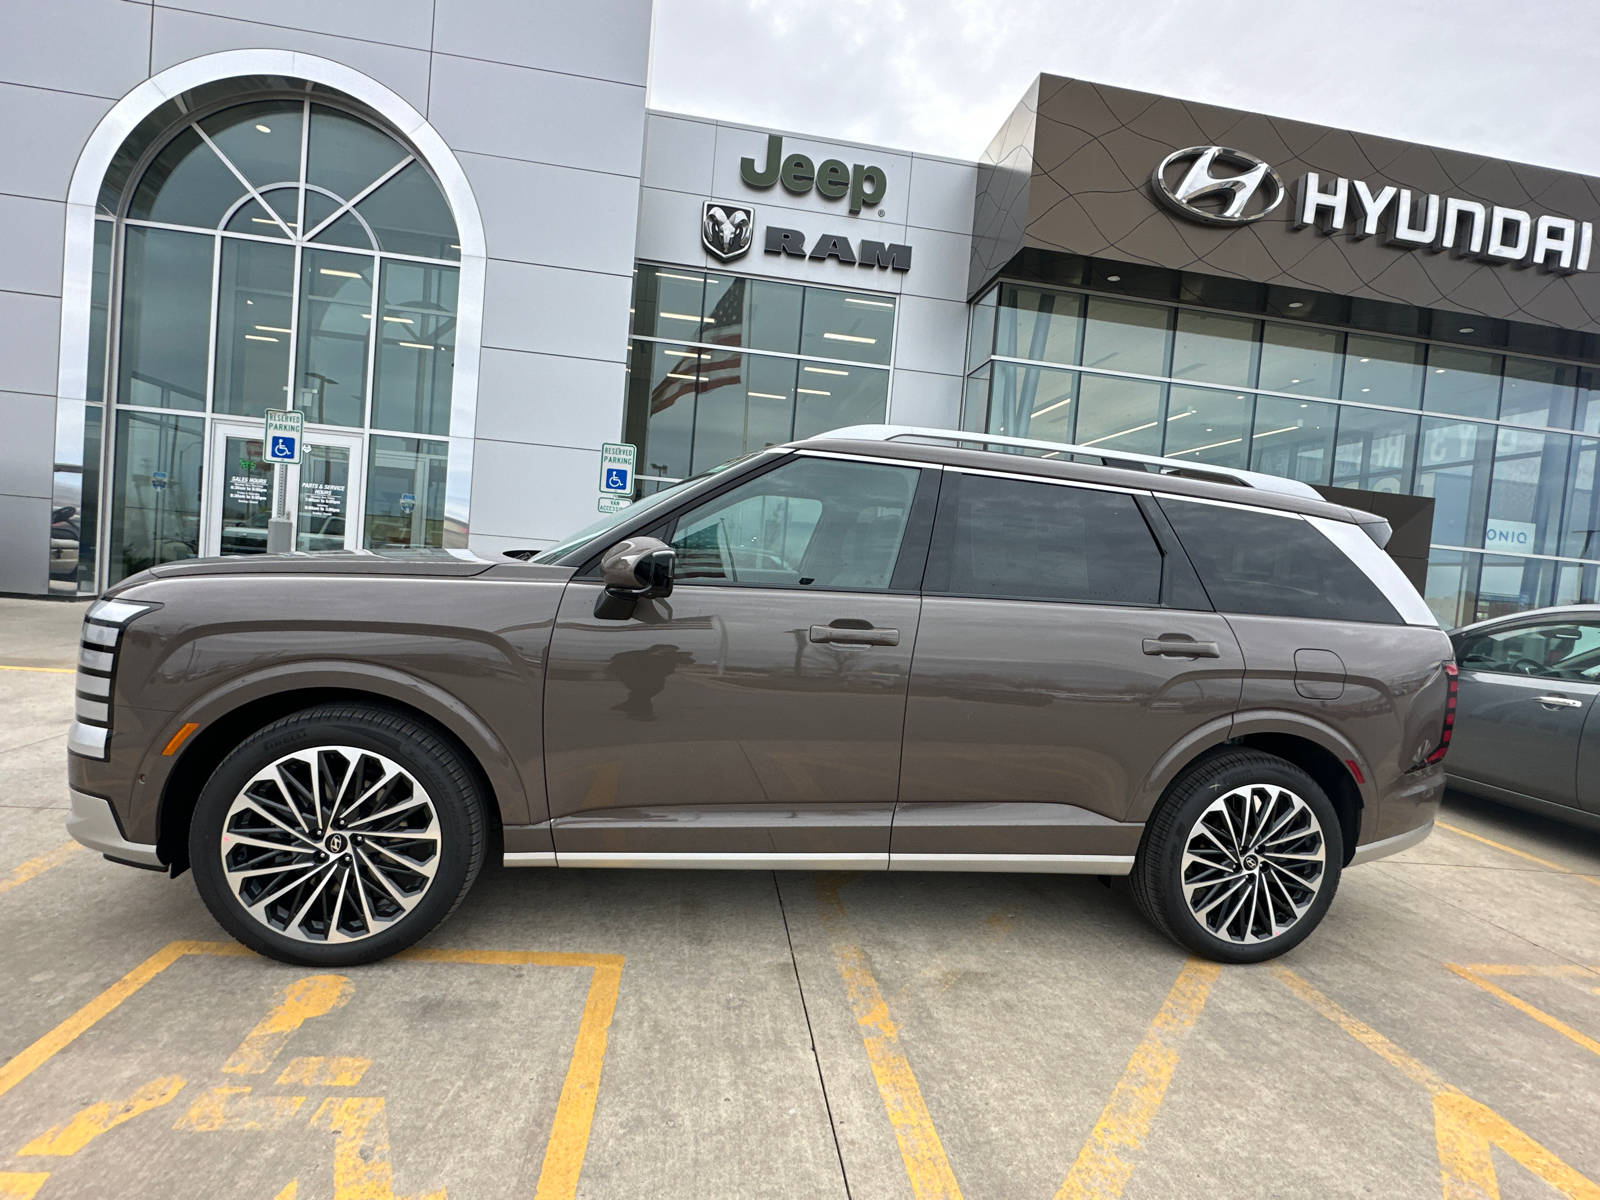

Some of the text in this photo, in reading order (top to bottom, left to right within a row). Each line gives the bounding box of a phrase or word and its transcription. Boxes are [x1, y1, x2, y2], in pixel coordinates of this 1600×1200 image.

[739, 134, 888, 215] Jeep
[1296, 172, 1593, 273] HYUNDAI
[764, 225, 913, 273] RAM
[270, 414, 300, 424] RESERVED
[269, 423, 300, 432] PARKING
[605, 447, 632, 456] RESERVED
[604, 456, 632, 465] PARKING
[249, 477, 267, 485] HOURS
[1486, 528, 1528, 544] ONIQ
